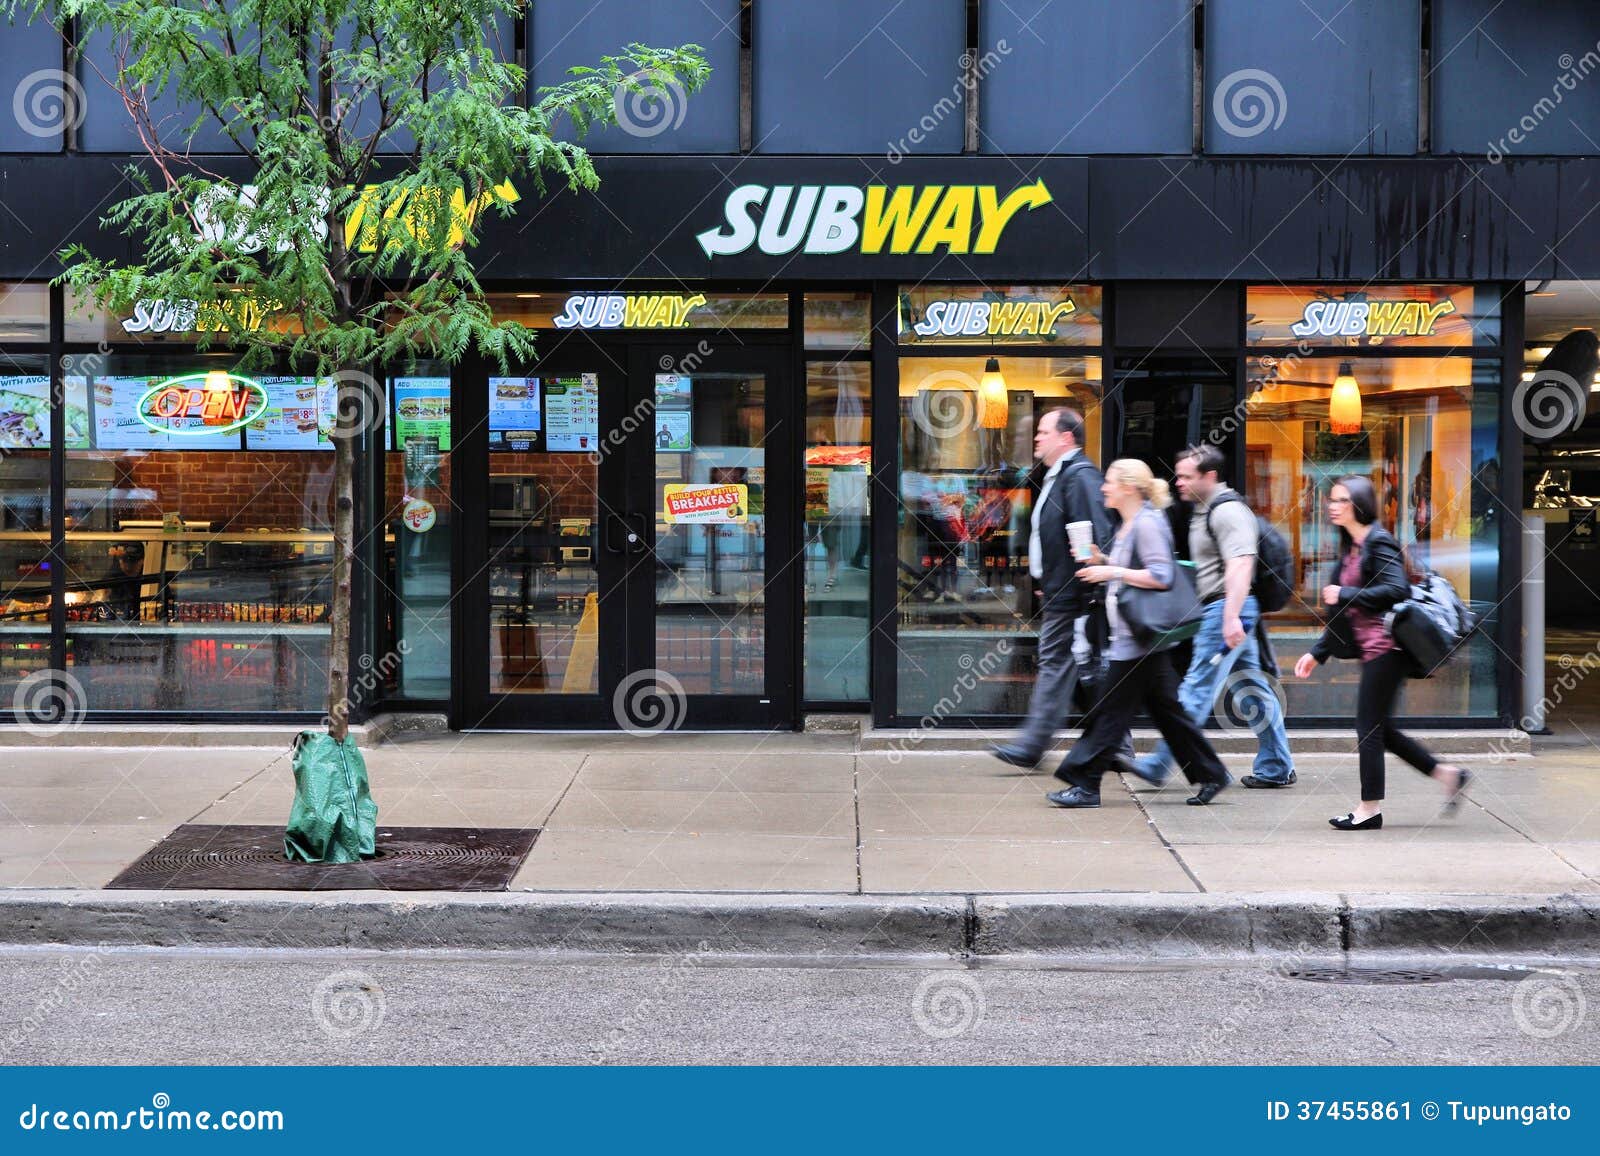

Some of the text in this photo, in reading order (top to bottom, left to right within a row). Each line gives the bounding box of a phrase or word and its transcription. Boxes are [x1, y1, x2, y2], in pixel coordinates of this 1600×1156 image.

[696, 177, 1052, 258] SUBWAY
[553, 294, 707, 328] SUBWAY
[913, 300, 1076, 336] SUBWAY
[1291, 300, 1456, 336] SUBWAY
[155, 387, 249, 420] OPEN
[672, 493, 739, 511] BREAKFAST
[692, 488, 711, 498] YOUR
